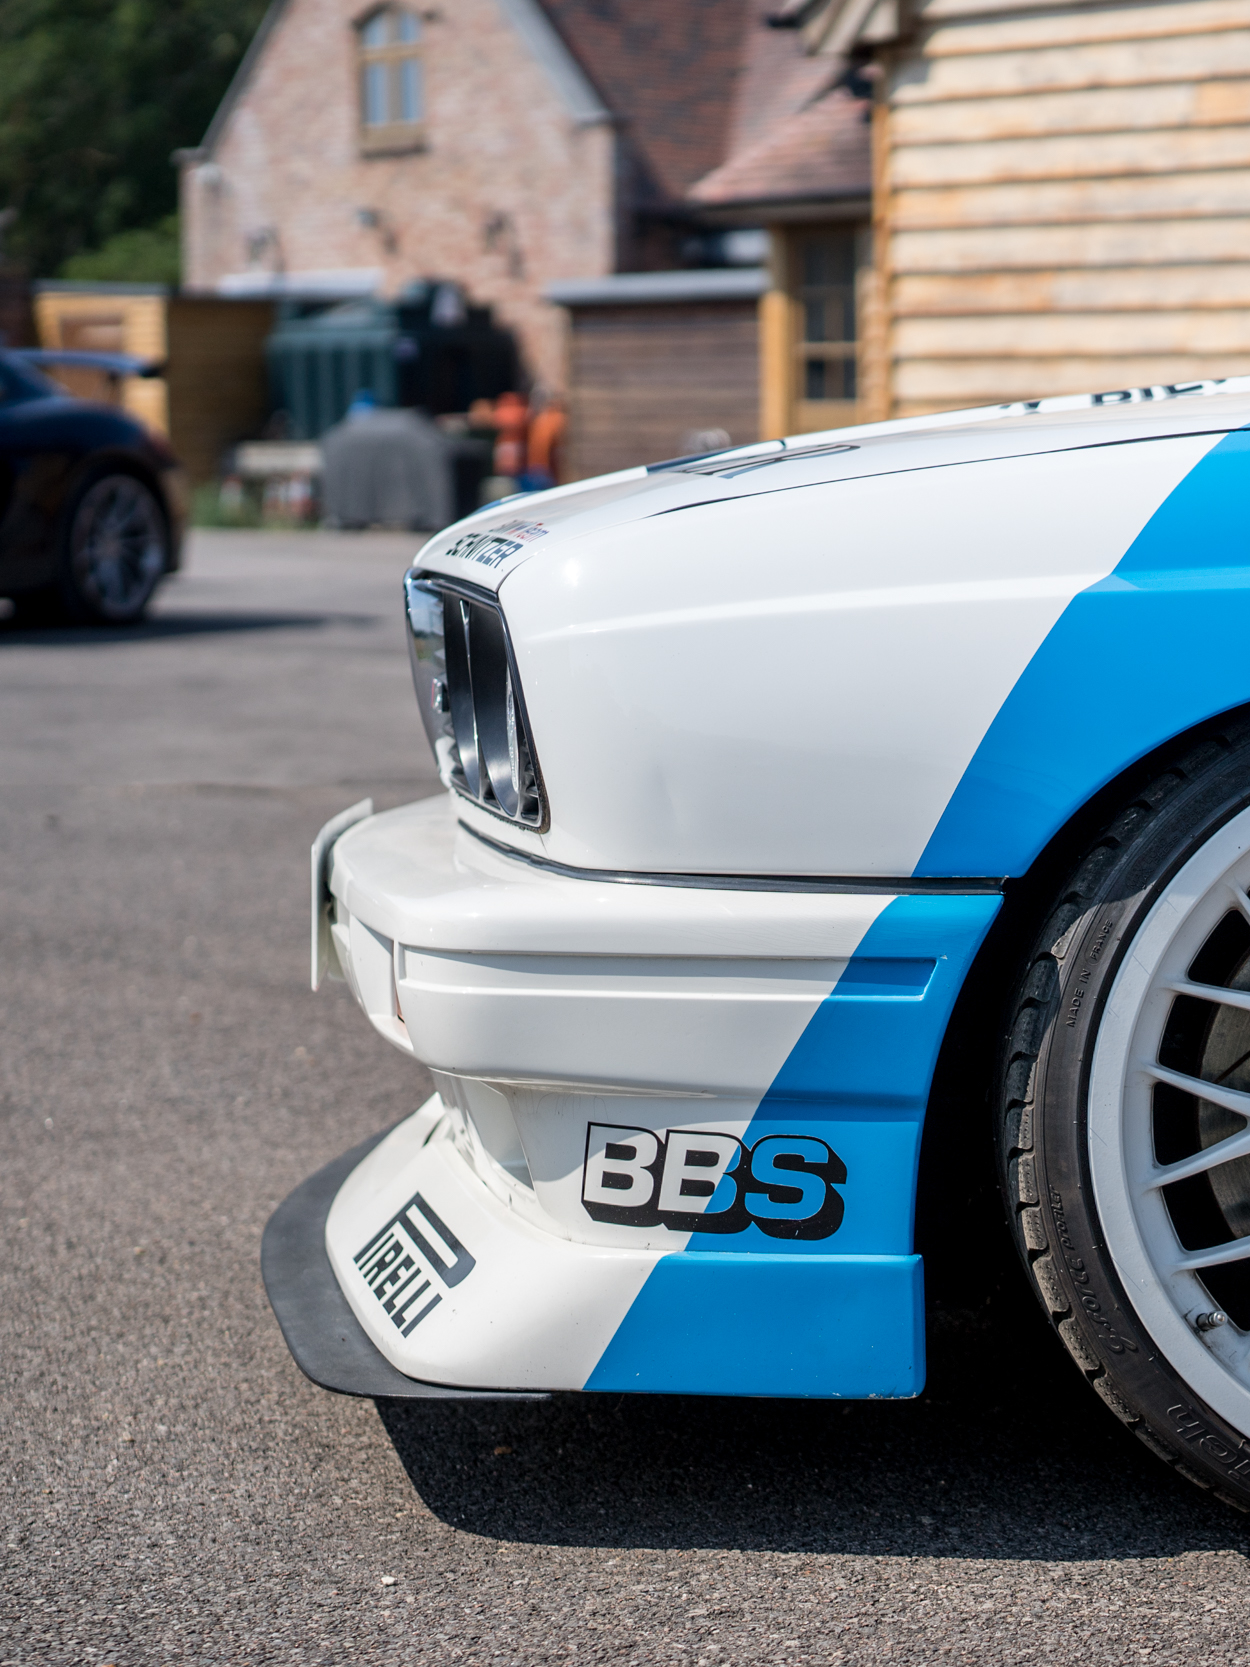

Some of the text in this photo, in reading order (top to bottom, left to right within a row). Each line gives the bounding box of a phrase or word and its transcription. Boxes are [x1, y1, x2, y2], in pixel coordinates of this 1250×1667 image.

[445, 532, 524, 569] SCHNITZER
[1066, 920, 1113, 1028] MADE IN FRANCE
[581, 1121, 848, 1241] BBS
[352, 1190, 477, 1338] PIRELLI
